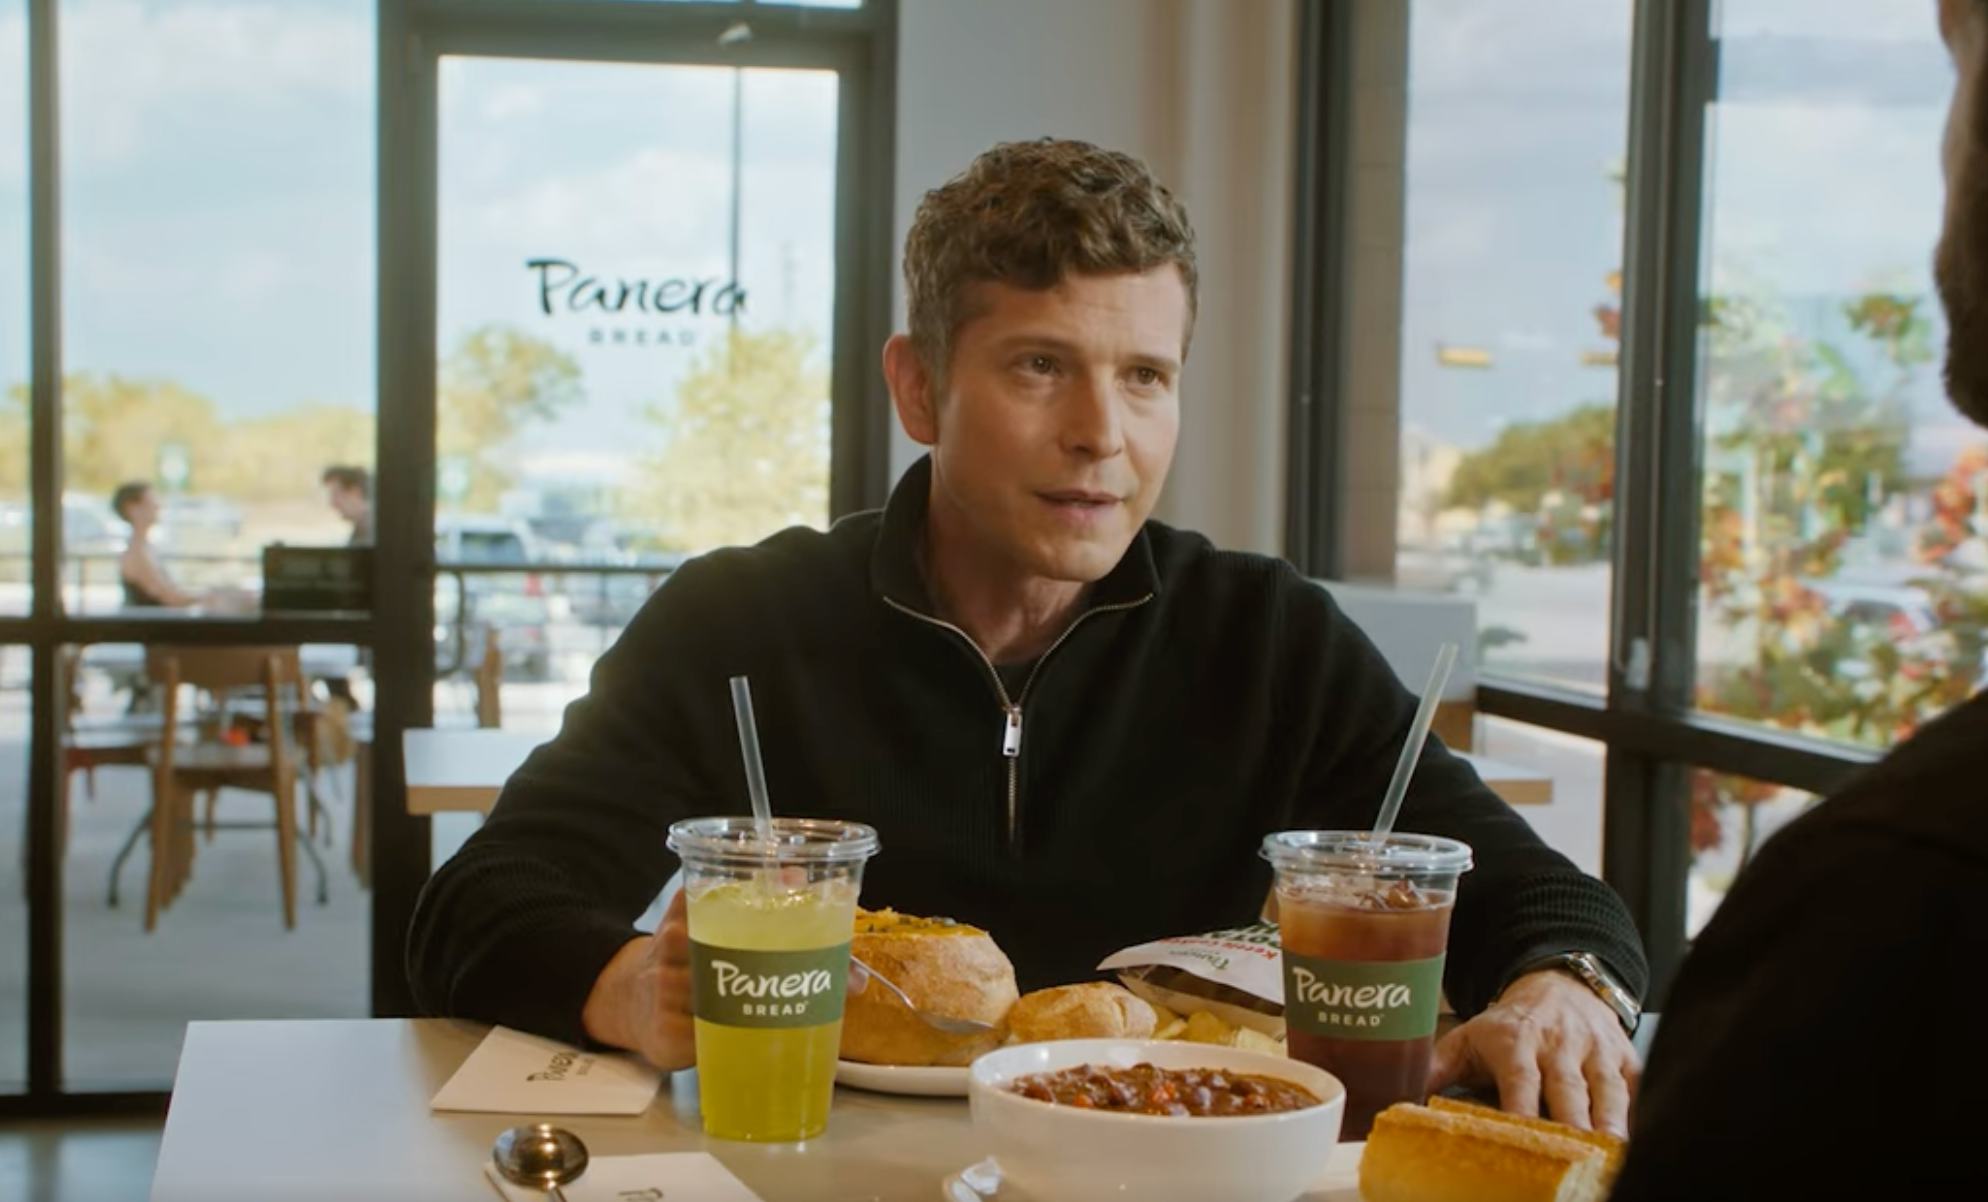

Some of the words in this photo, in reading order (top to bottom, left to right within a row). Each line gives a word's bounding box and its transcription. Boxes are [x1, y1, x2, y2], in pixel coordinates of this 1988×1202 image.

[525, 258, 747, 316] Panera
[589, 329, 694, 346] BREAD
[711, 959, 832, 998] Panera
[1292, 966, 1412, 1009] Panera
[742, 1003, 808, 1017] BREAD
[1317, 1012, 1382, 1027] BREAD
